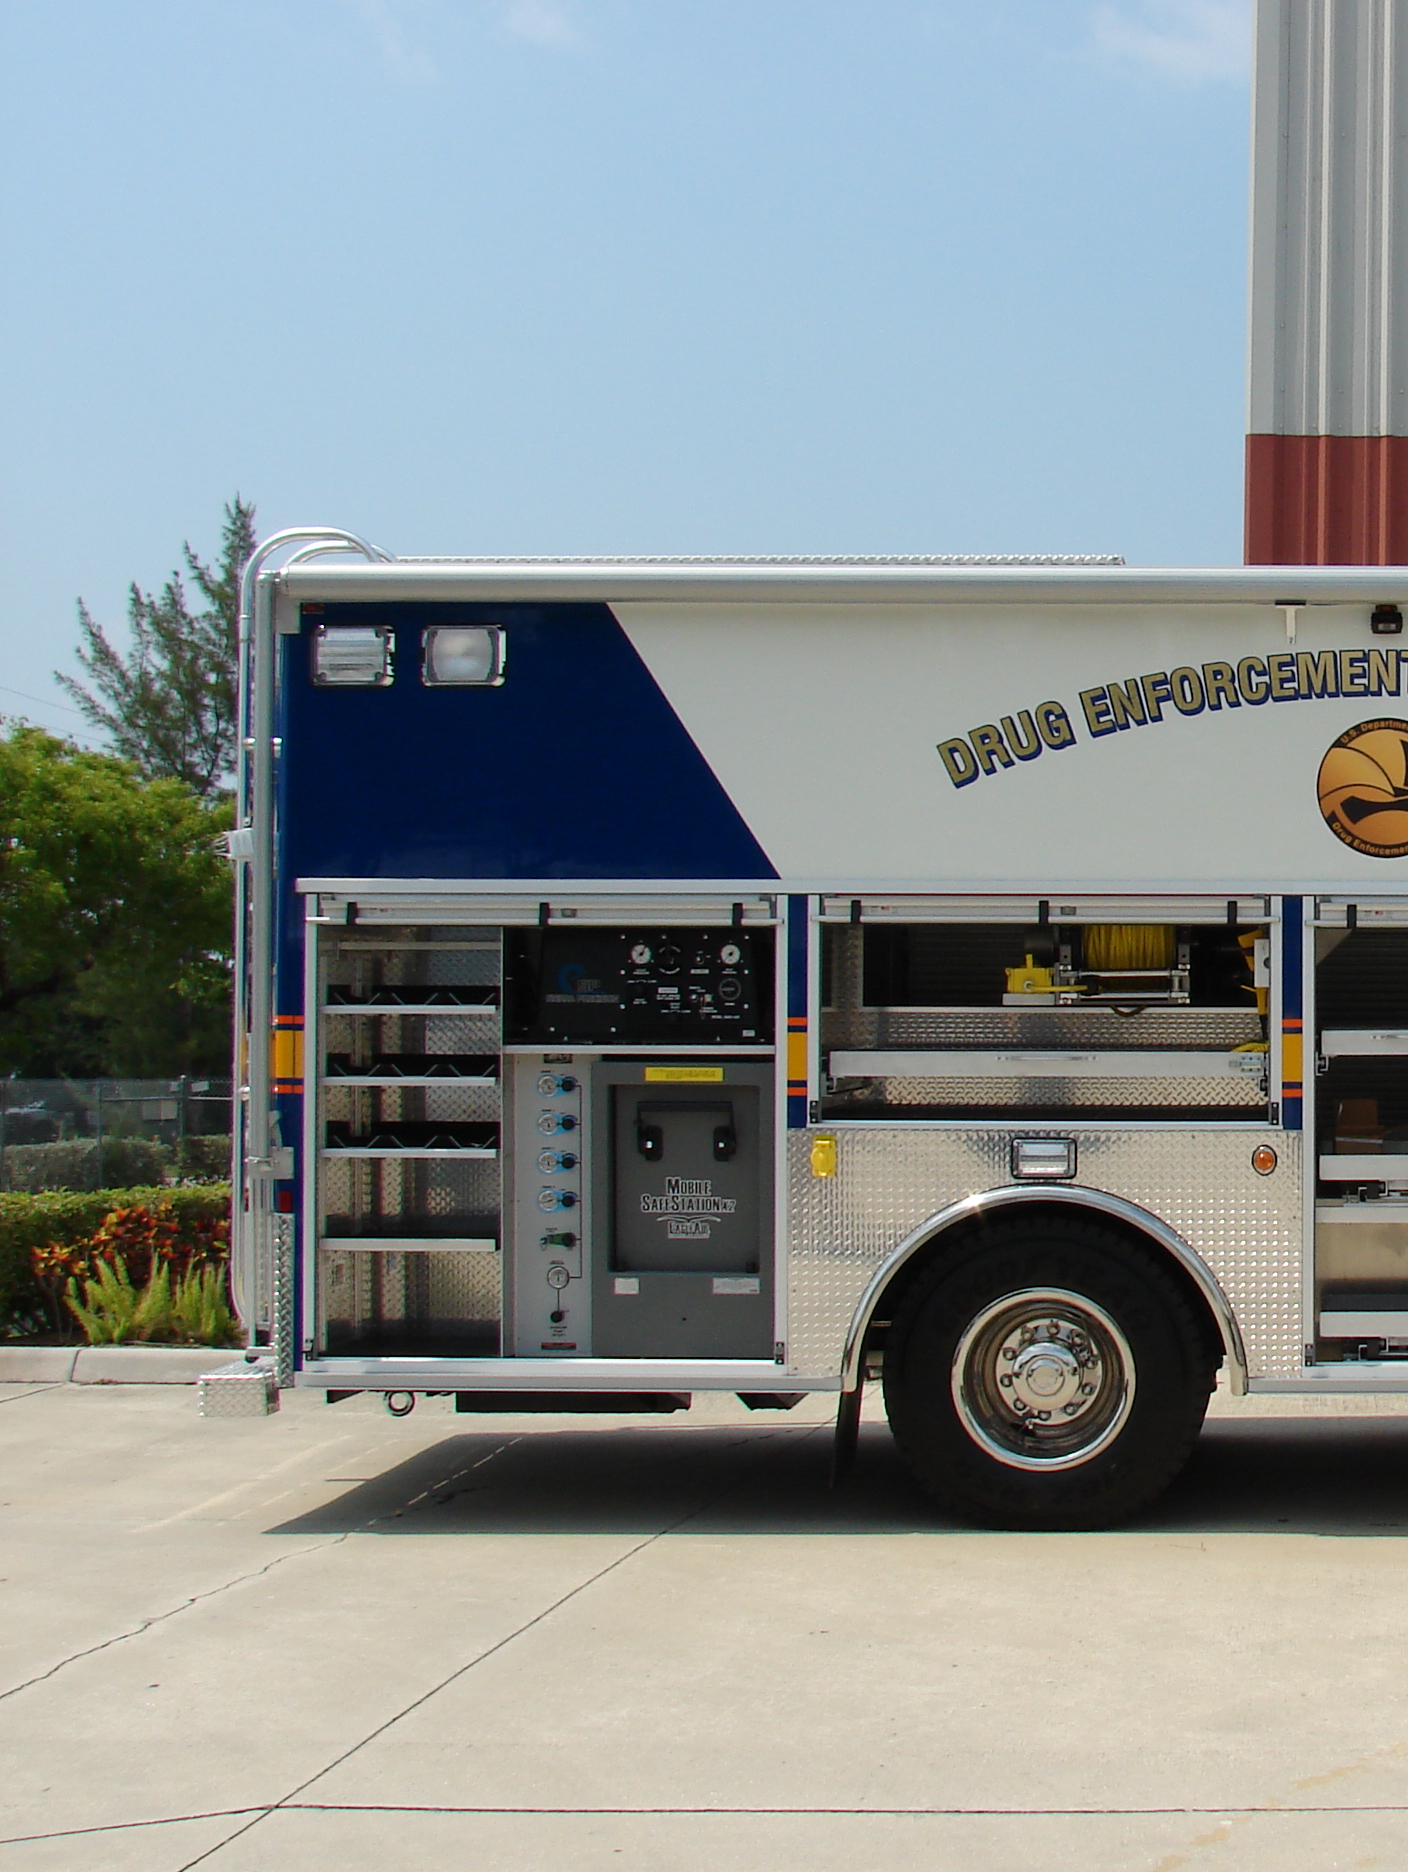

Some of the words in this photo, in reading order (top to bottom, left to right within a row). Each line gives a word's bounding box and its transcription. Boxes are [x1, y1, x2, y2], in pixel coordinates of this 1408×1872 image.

[936, 700, 1077, 789] DRUG
[1340, 729, 1359, 744] U.S.
[1332, 821, 1353, 844] Drug
[666, 1177, 711, 1195] MOBILE
